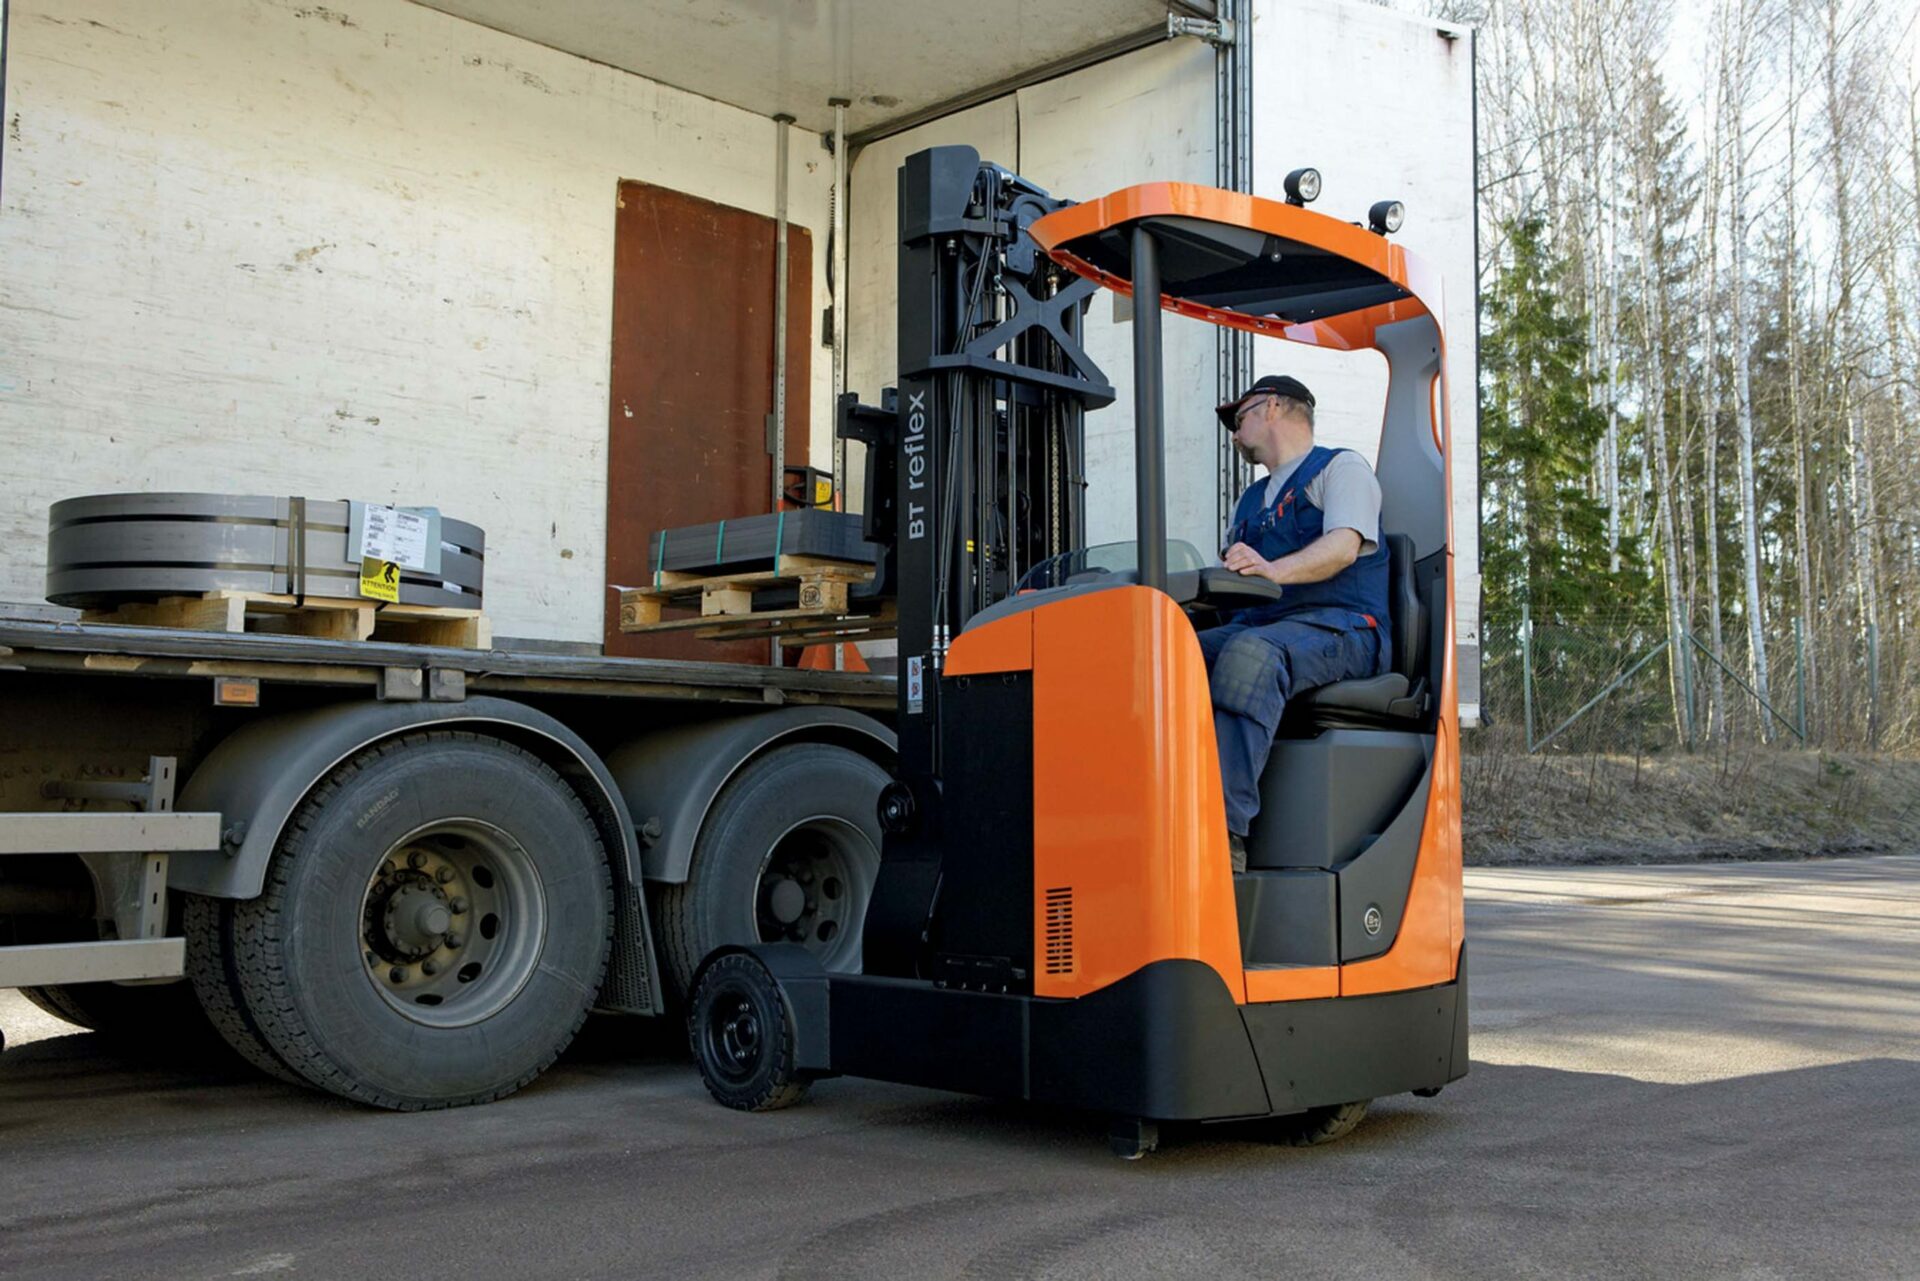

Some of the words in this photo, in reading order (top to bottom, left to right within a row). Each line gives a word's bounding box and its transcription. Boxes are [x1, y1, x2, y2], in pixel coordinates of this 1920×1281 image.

[904, 390, 925, 490] reflex
[909, 502, 924, 539] BT
[362, 579, 397, 592] ATTENTION
